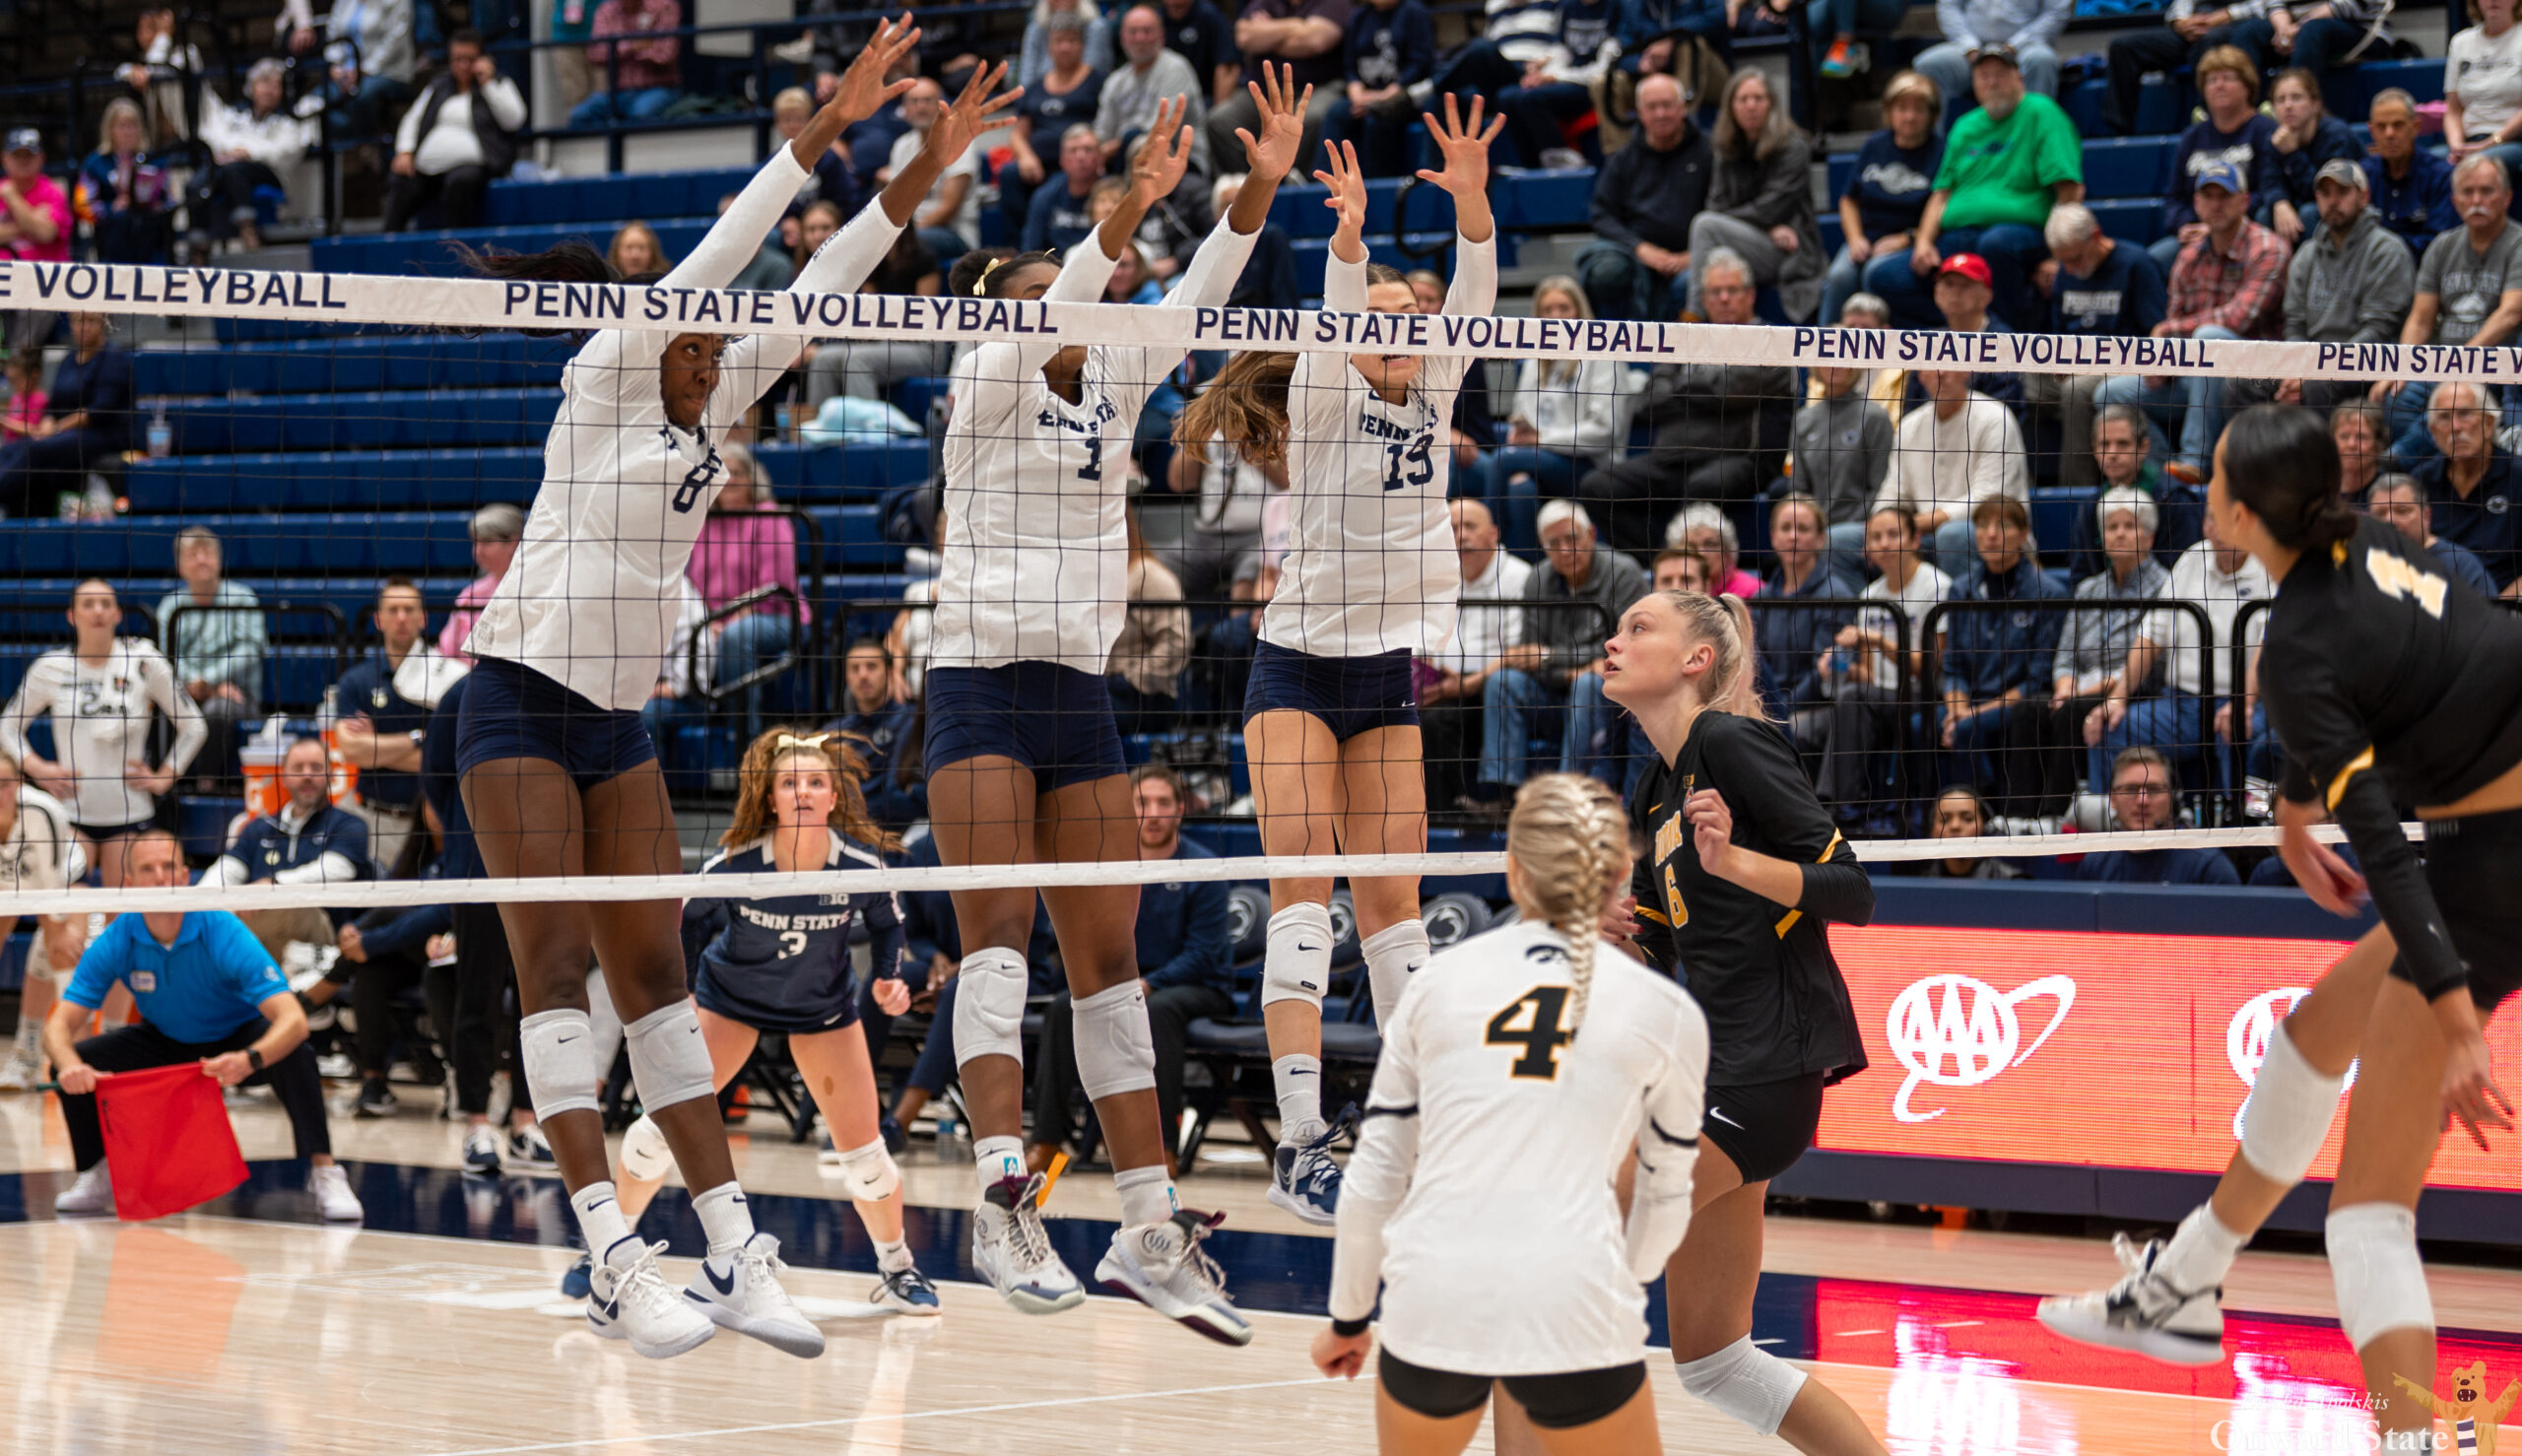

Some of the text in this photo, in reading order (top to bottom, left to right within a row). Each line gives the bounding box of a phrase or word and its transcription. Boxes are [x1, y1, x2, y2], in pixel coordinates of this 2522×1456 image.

[33, 263, 347, 308] VOLLEYBALL
[504, 282, 1058, 334] PENN STATE VOLLEYBALL
[1195, 307, 1675, 354] PENN STATE VOLLEYBALL
[1793, 327, 2215, 367] PENN STATE VOLLEYBALL
[2317, 343, 2400, 372] PENN
[2410, 345, 2498, 374] STATE
[1077, 436, 1102, 482] 1
[672, 464, 714, 514] 8
[740, 904, 850, 931] PENN STATE
[1665, 863, 1689, 929] 6
[777, 930, 808, 960] 3
[1484, 984, 1577, 1083] 4
[1893, 977, 2010, 1084] AAA
